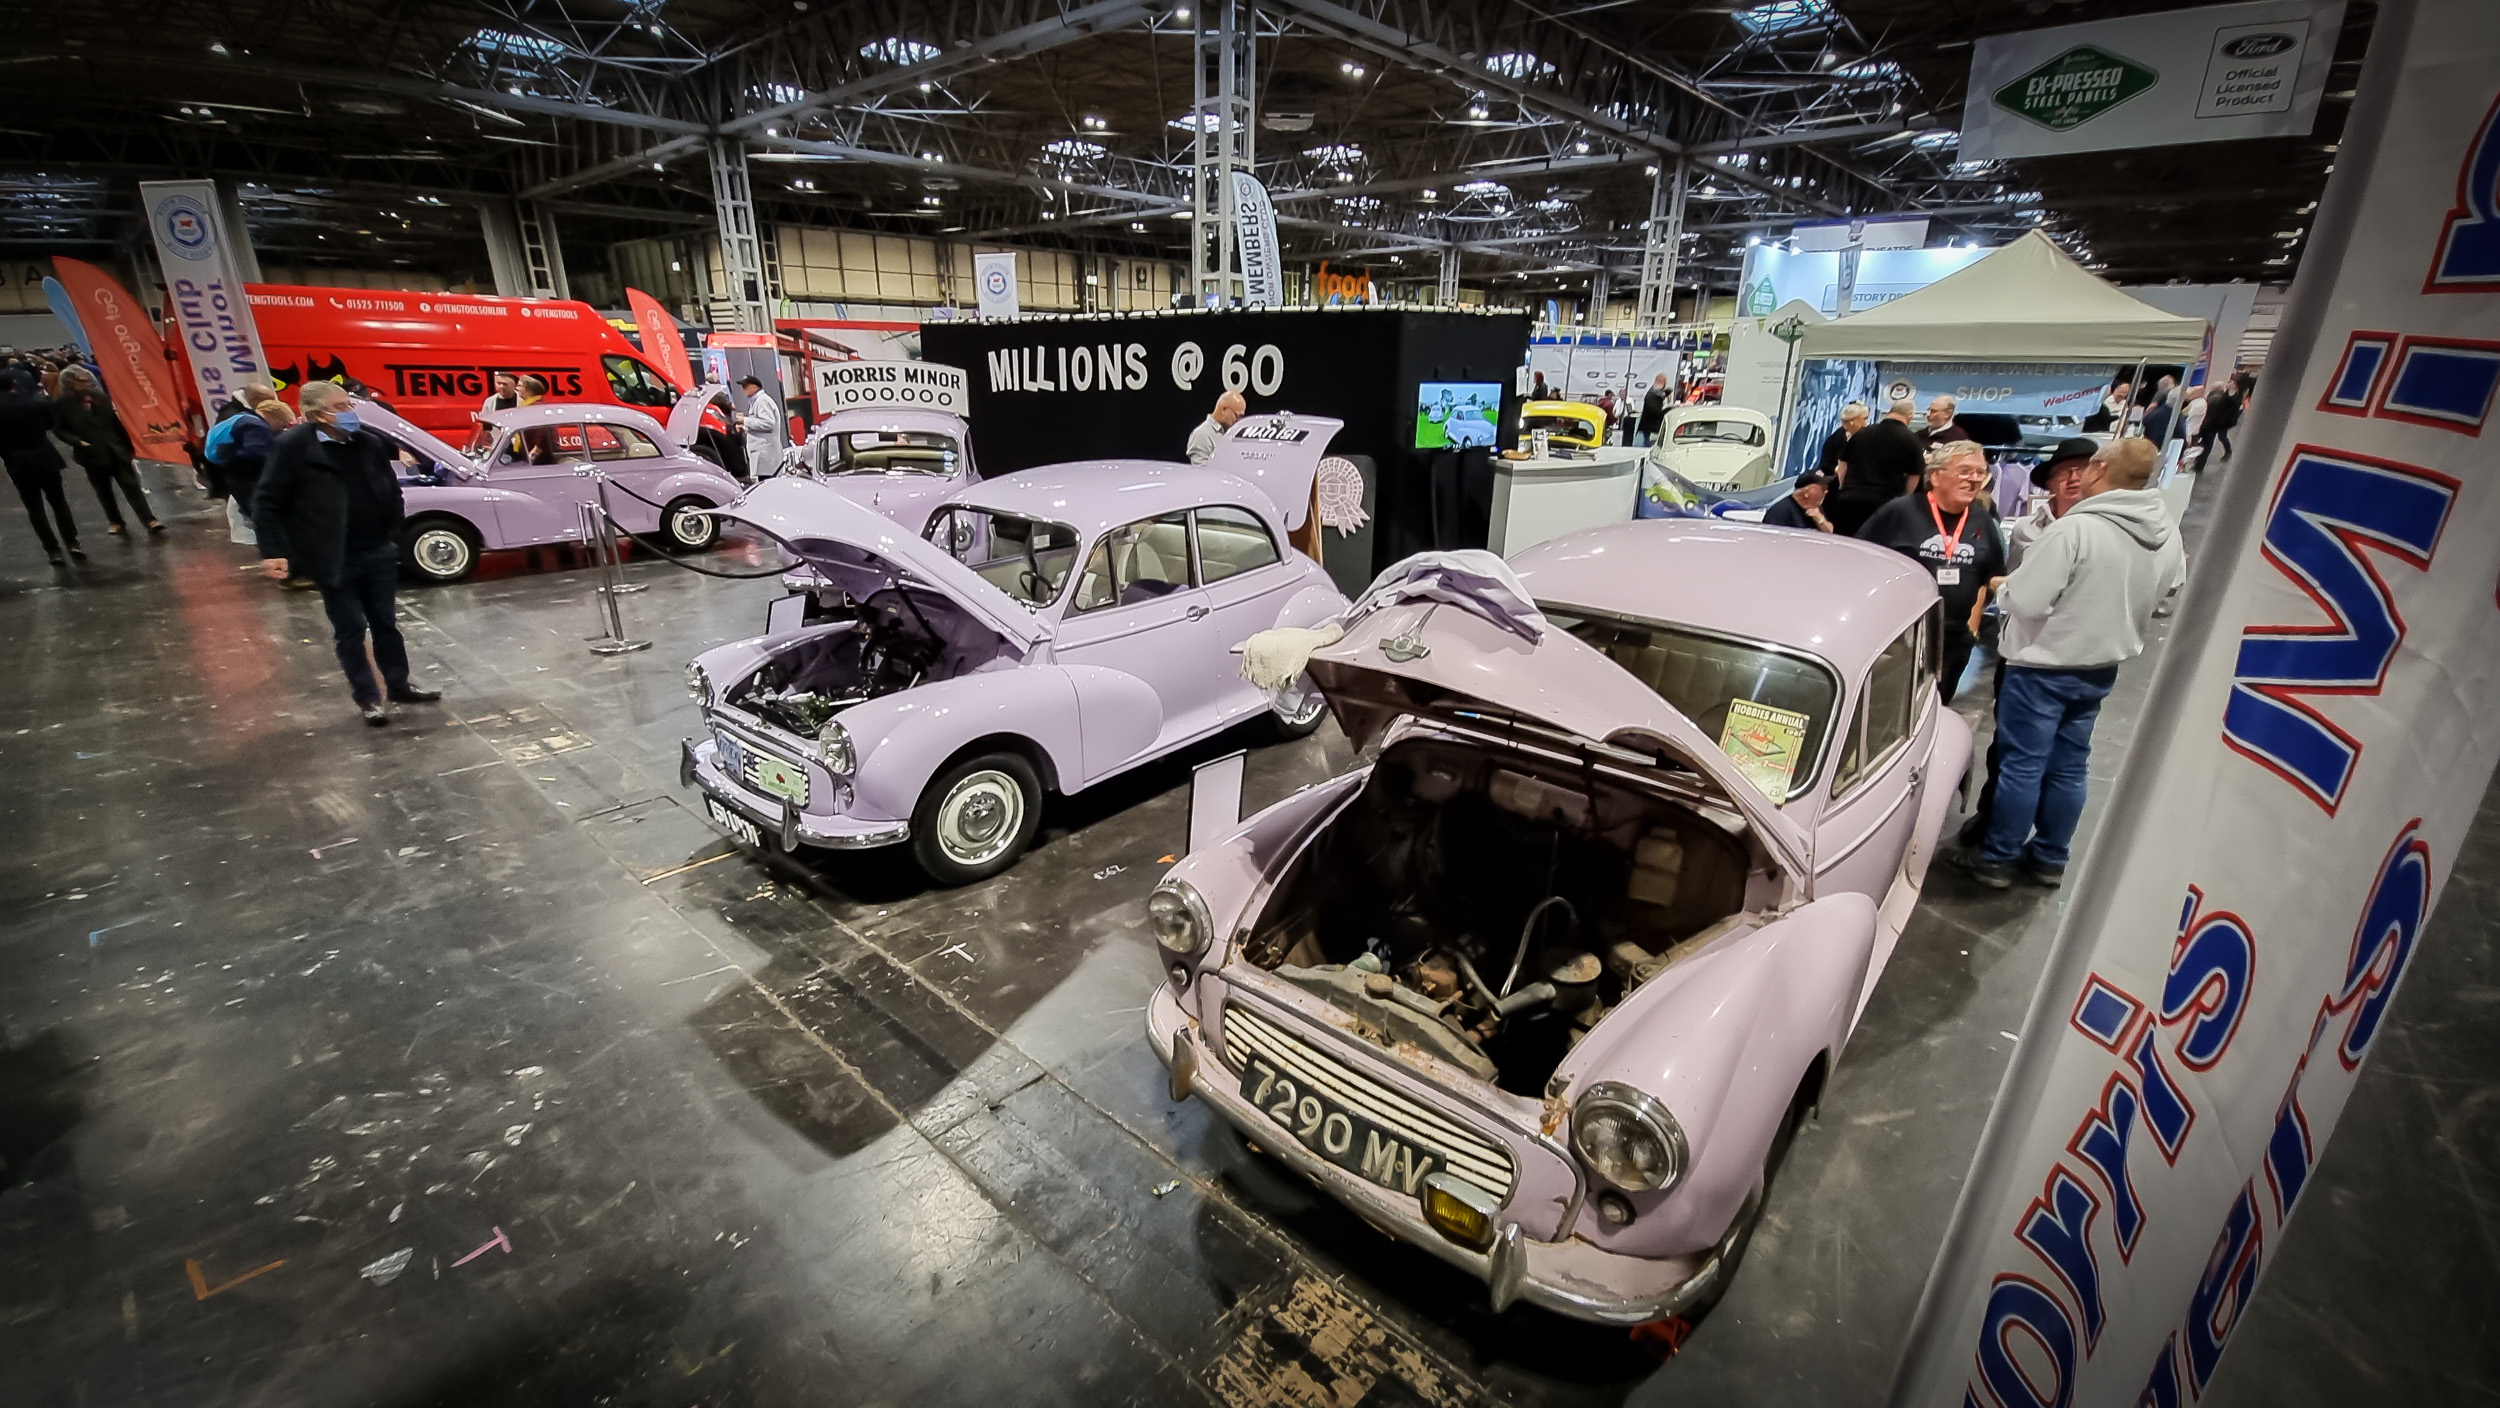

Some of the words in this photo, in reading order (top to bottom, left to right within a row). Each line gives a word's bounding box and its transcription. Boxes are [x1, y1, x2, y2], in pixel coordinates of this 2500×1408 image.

[2234, 36, 2283, 56] Ford
[2026, 66, 2124, 97] EX-PRESSED
[2225, 66, 2279, 81] Official
[2024, 93, 2062, 110] STEEL
[2066, 87, 2118, 105] PANELS
[2215, 79, 2282, 95] Licensed
[2215, 94, 2275, 108] Product
[1318, 260, 1371, 300] food
[384, 363, 583, 397] TENGTLS
[822, 366, 897, 388] MORRIS
[904, 366, 961, 391] MINOR
[987, 342, 1149, 393] MILLIONS
[1171, 341, 1204, 391] @
[1221, 343, 1285, 397] 60
[1955, 386, 2014, 402] SHOP
[2042, 385, 2102, 409] Welcome
[1733, 703, 1770, 721] HOBBIES
[1769, 712, 1805, 729] ANNUAL
[1253, 1059, 1353, 1155] 7290
[1361, 1129, 1434, 1195] MV
[1963, 884, 2257, 1408] orris
